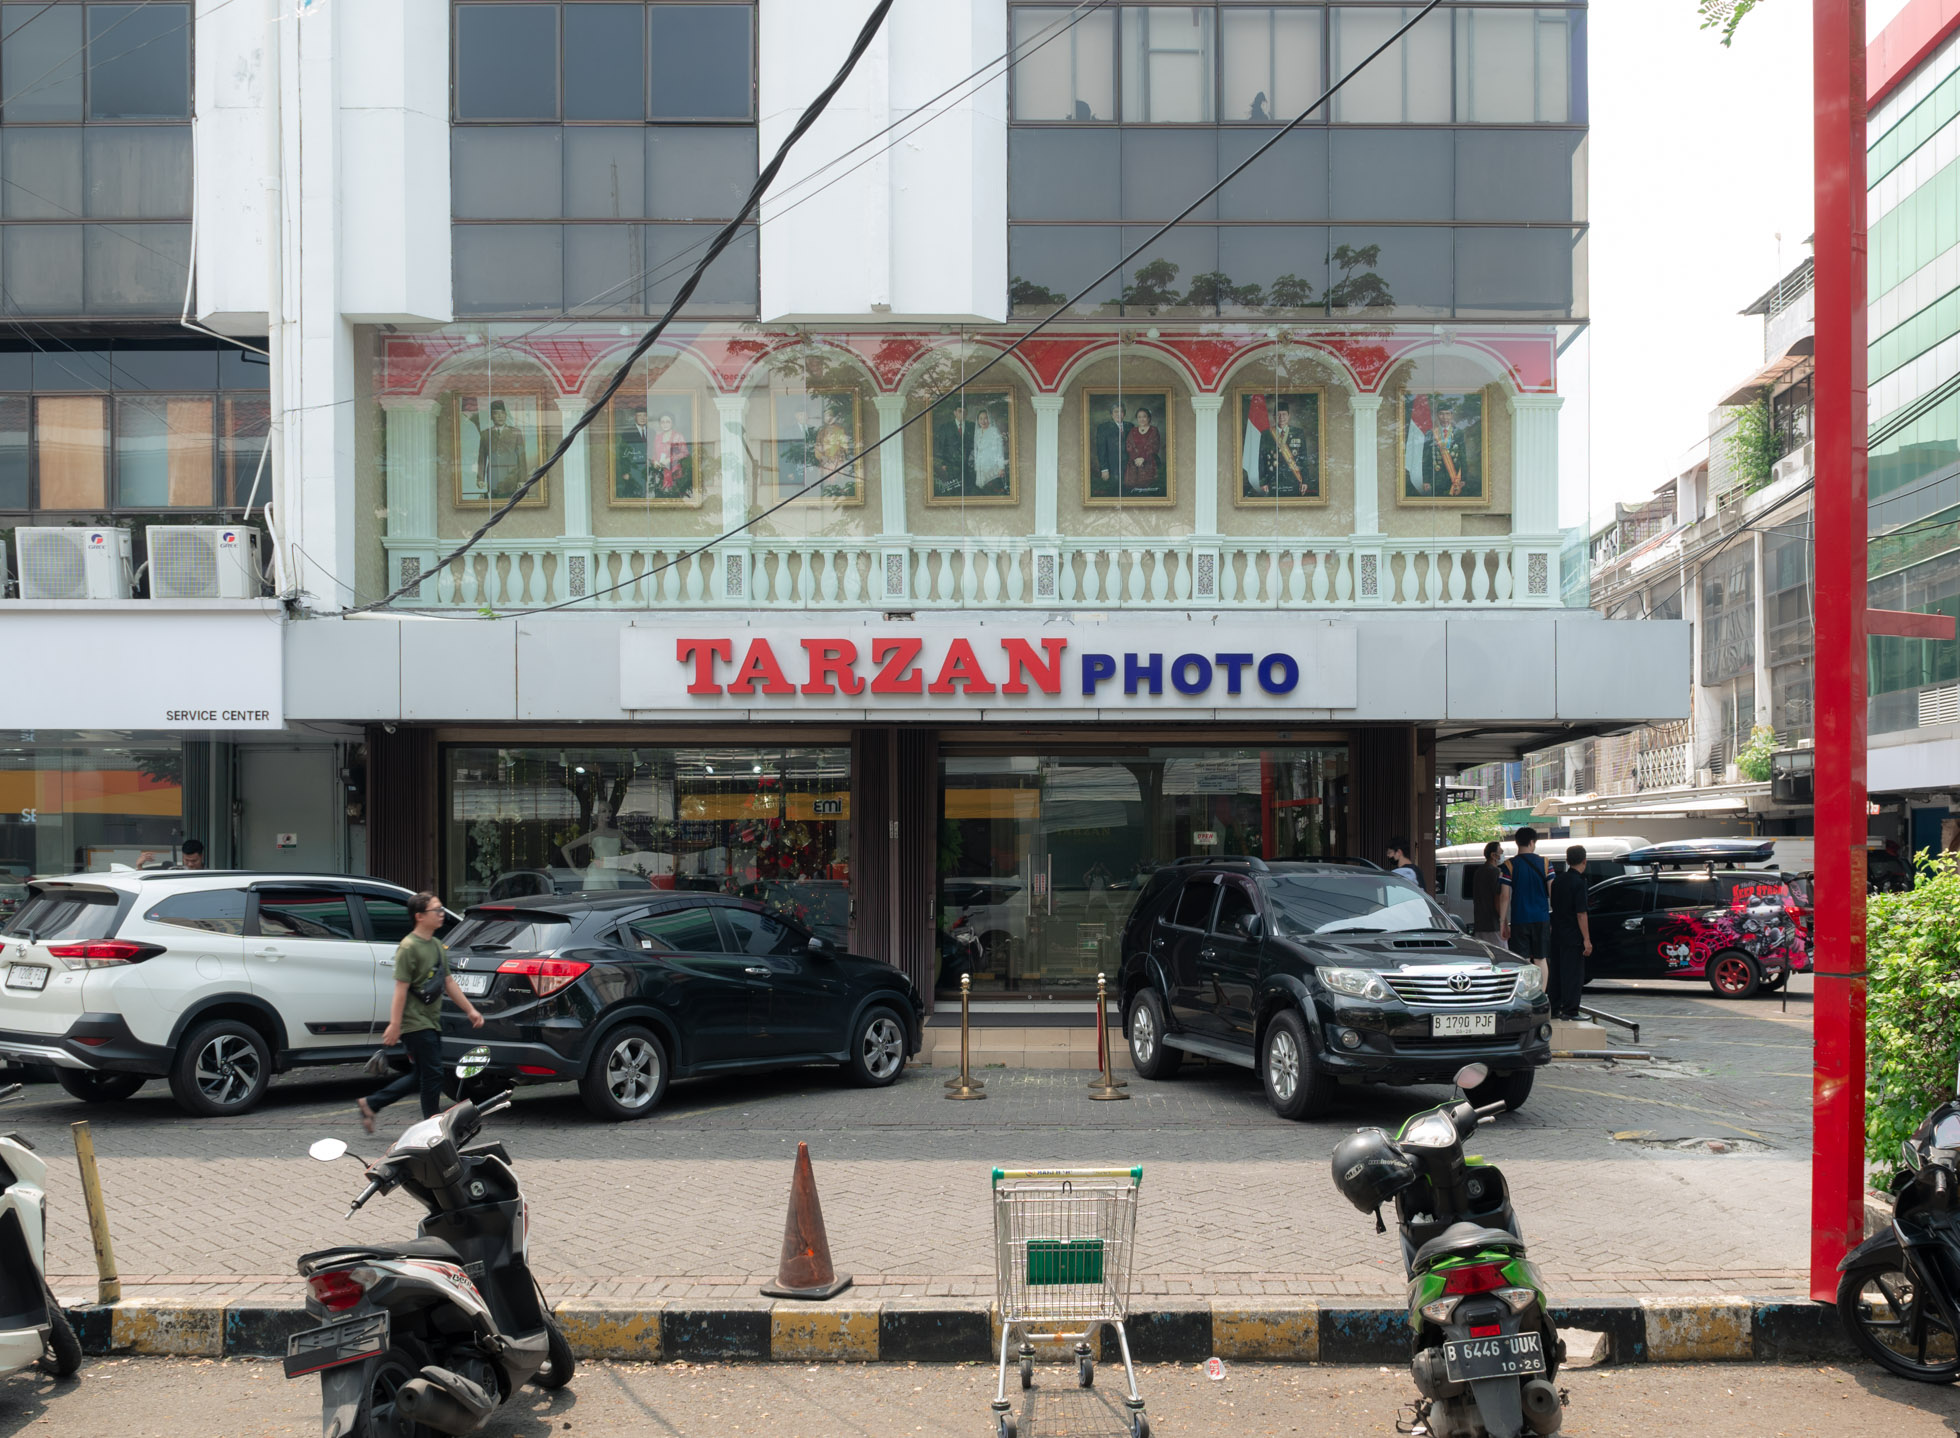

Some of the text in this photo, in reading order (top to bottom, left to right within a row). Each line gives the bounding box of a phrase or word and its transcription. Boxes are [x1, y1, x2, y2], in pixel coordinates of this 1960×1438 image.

[676, 637, 1300, 696] TARZAN PHOTO
[166, 710, 270, 721] SERVICE CENTER
[1435, 1015, 1494, 1029] B 1790 PJF
[1447, 1336, 1540, 1361] B 6446 UUK
